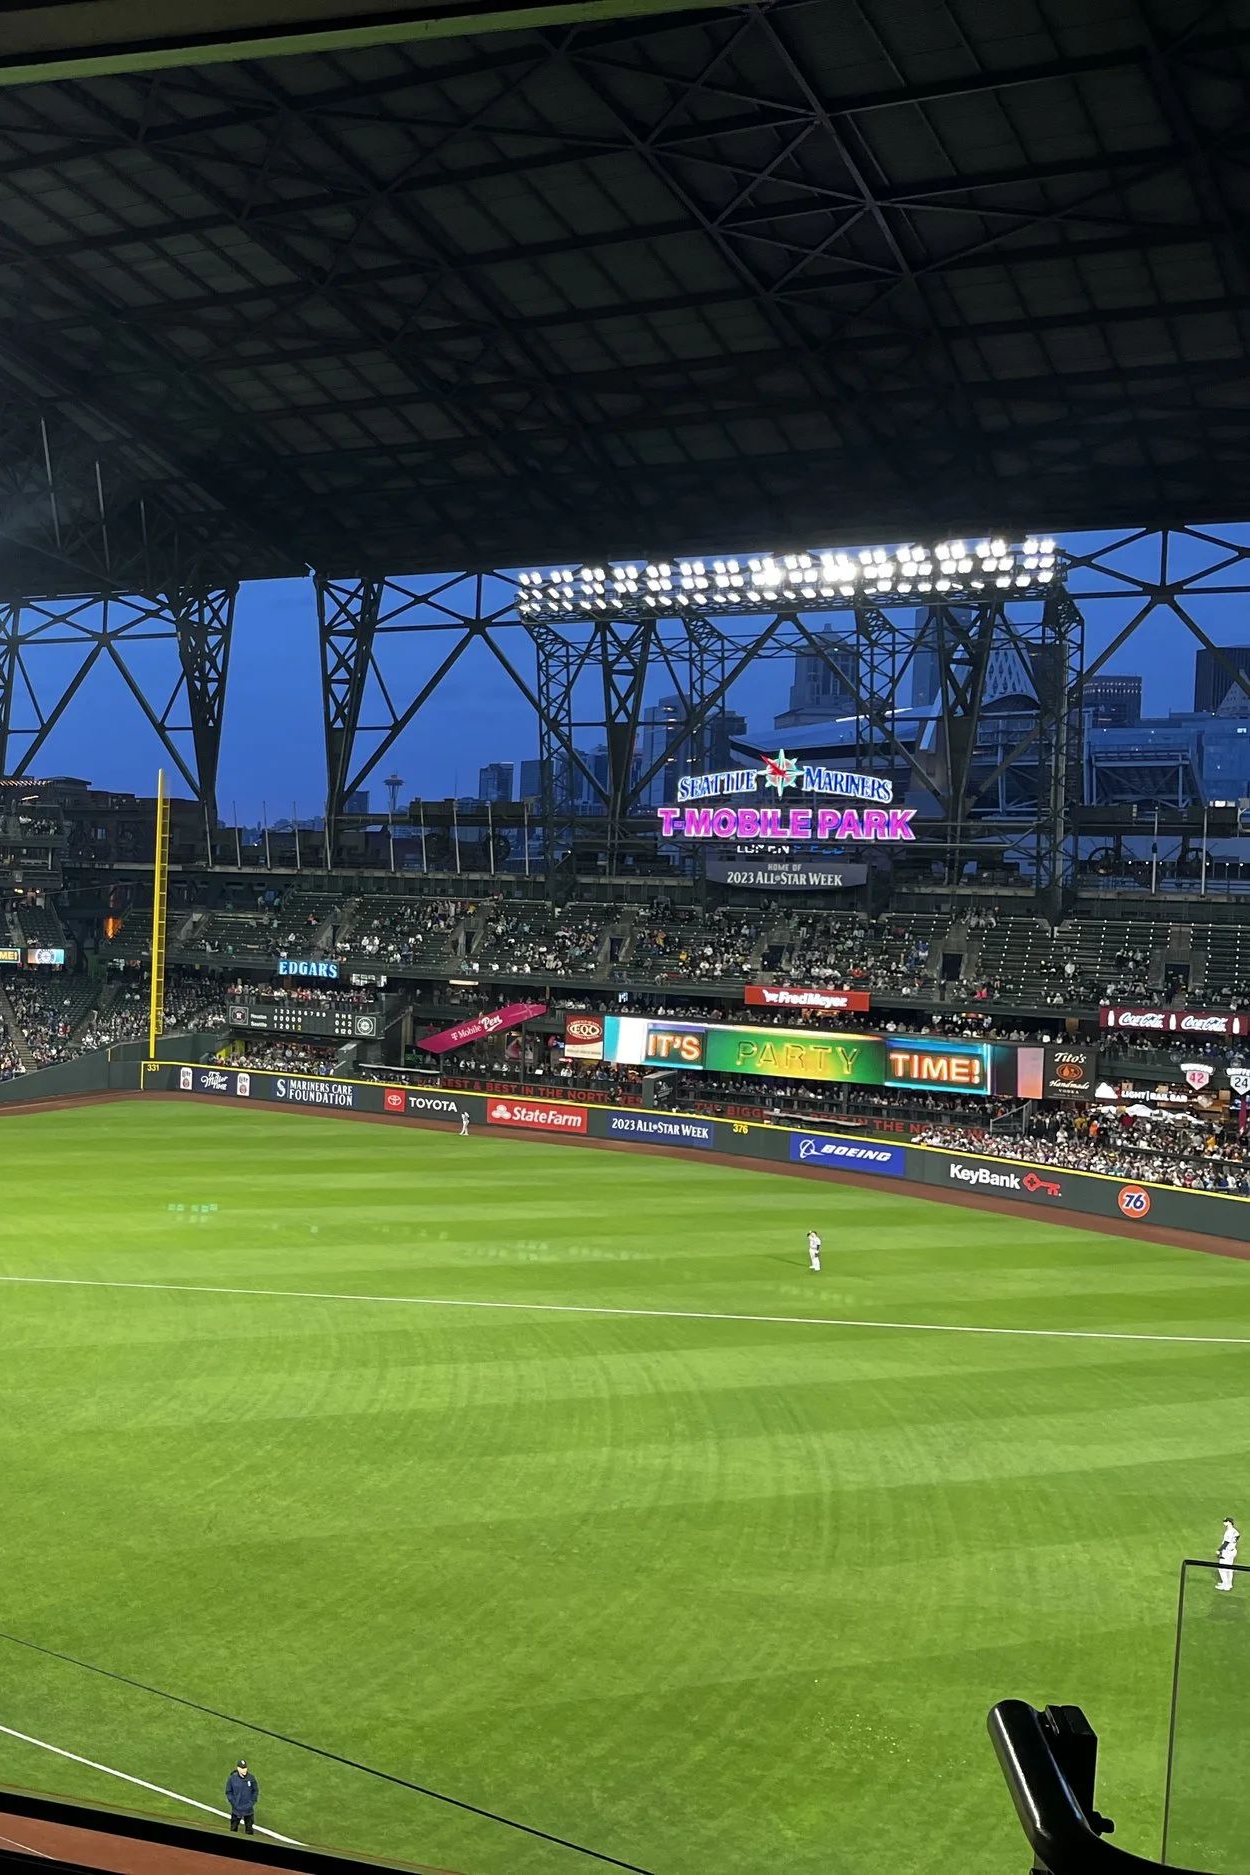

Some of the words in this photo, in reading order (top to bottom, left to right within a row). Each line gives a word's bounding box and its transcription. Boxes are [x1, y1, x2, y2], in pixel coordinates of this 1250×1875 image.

[678, 769, 757, 802] SEATTLE
[802, 765, 893, 803] MARINERS
[658, 807, 812, 839] T-MOBILE
[817, 808, 918, 840] PARK
[768, 864, 789, 872] HOME
[727, 871, 754, 884] 2023
[808, 872, 842, 886] WEEK
[458, 1024, 482, 1038] Mobile
[648, 1034, 700, 1060] IT'S
[736, 1040, 858, 1074] PARTY
[890, 1053, 980, 1084] TIME!
[1054, 1052, 1086, 1064] Tito's
[147, 1064, 160, 1072] 331
[1190, 1072, 1204, 1084] 42
[1234, 1077, 1248, 1088] 24
[289, 1080, 330, 1093] MARINERS
[331, 1083, 353, 1096] CARE
[486, 1081, 518, 1094] BEST
[521, 1084, 534, 1095] IN
[538, 1087, 563, 1098] THE
[289, 1090, 353, 1106] FOUNDATION
[409, 1096, 457, 1112] TOYOTA
[612, 1118, 636, 1131] 2023
[682, 1123, 709, 1140] WEEK
[732, 1123, 748, 1134] 376
[873, 1120, 904, 1132] THE
[821, 1144, 893, 1162] BOEING
[950, 1164, 1021, 1190] KeyBank
[1122, 1194, 1145, 1210] 76
